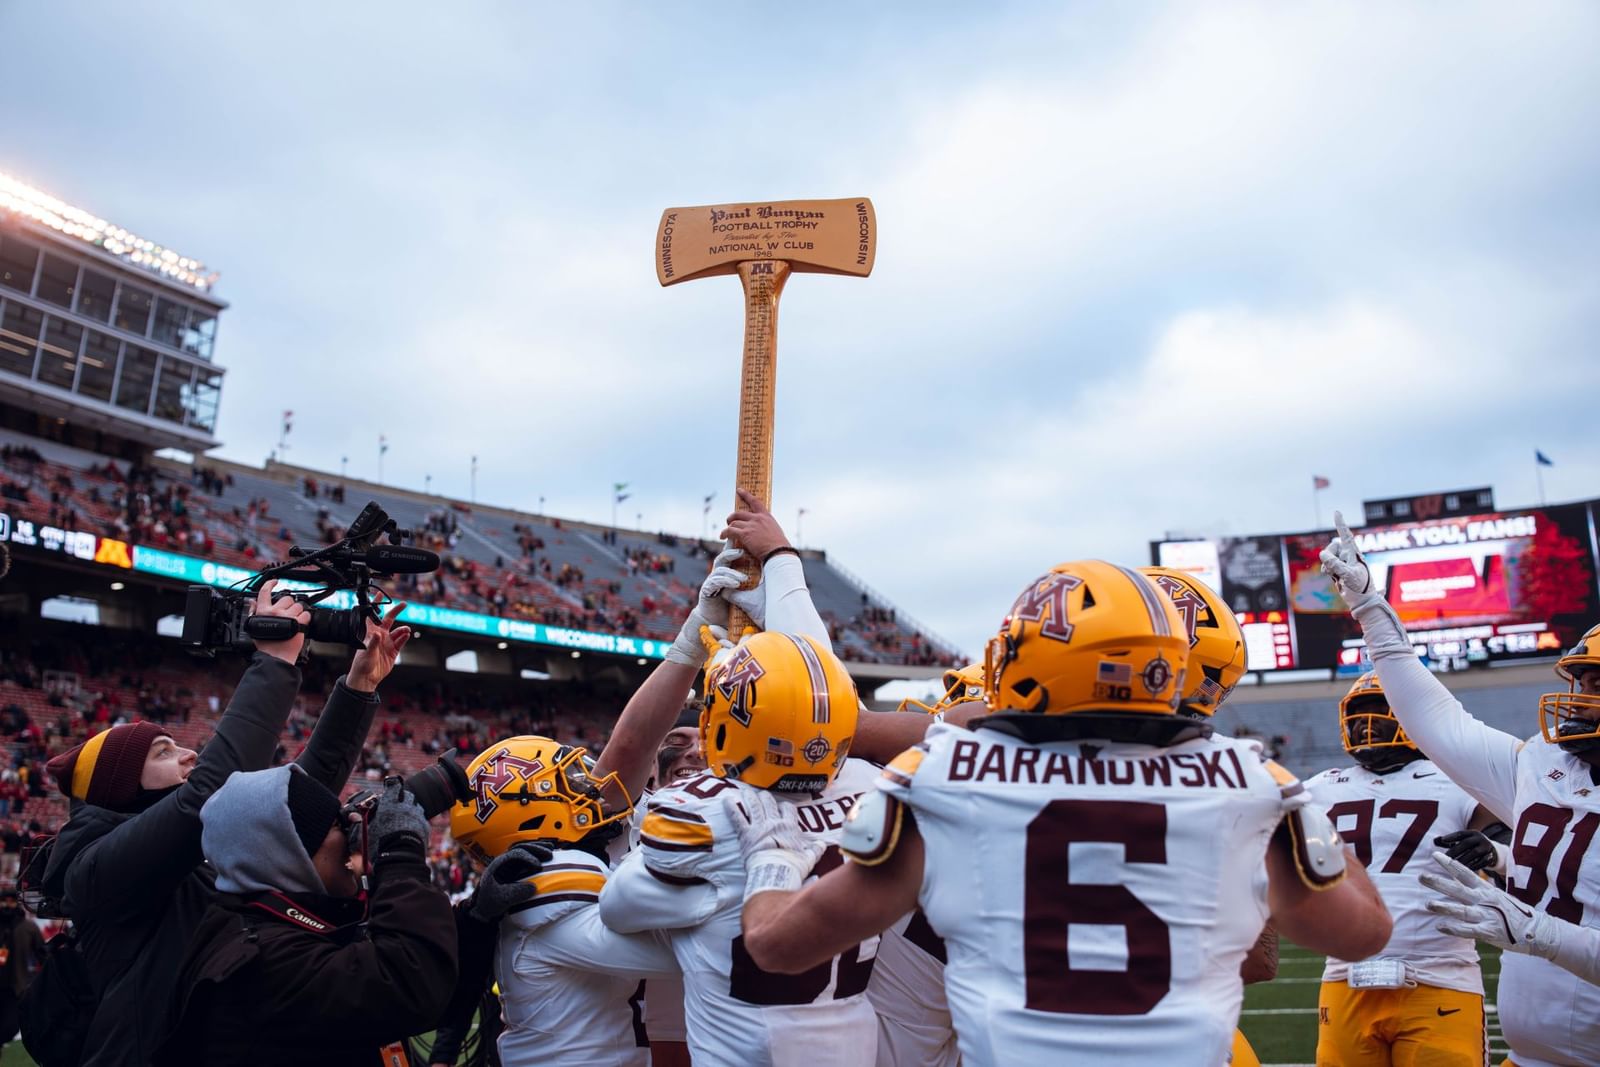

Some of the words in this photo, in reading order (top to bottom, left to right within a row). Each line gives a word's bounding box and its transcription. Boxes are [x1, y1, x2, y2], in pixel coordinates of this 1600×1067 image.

[710, 206, 751, 224] Paul
[757, 205, 825, 221] Bunyan
[712, 221, 773, 233] FOOTBALL
[776, 221, 819, 230] TROPHY
[855, 202, 869, 265] WISCONSIN
[662, 213, 678, 279] MINNESOTA
[709, 242, 763, 255] NATIONAL
[767, 241, 780, 250] W
[783, 241, 814, 250] CLUB
[753, 250, 773, 258] 1948
[751, 262, 774, 274] M
[1347, 530, 1412, 554] HANK
[1410, 523, 1467, 547] YOU,
[1467, 515, 1537, 541] FANS!
[947, 739, 1249, 789] BARANOWSKI
[1326, 798, 1439, 874] 97
[1506, 801, 1600, 926] 91
[286, 908, 326, 930] Canon
[1023, 798, 1172, 1016] 6
